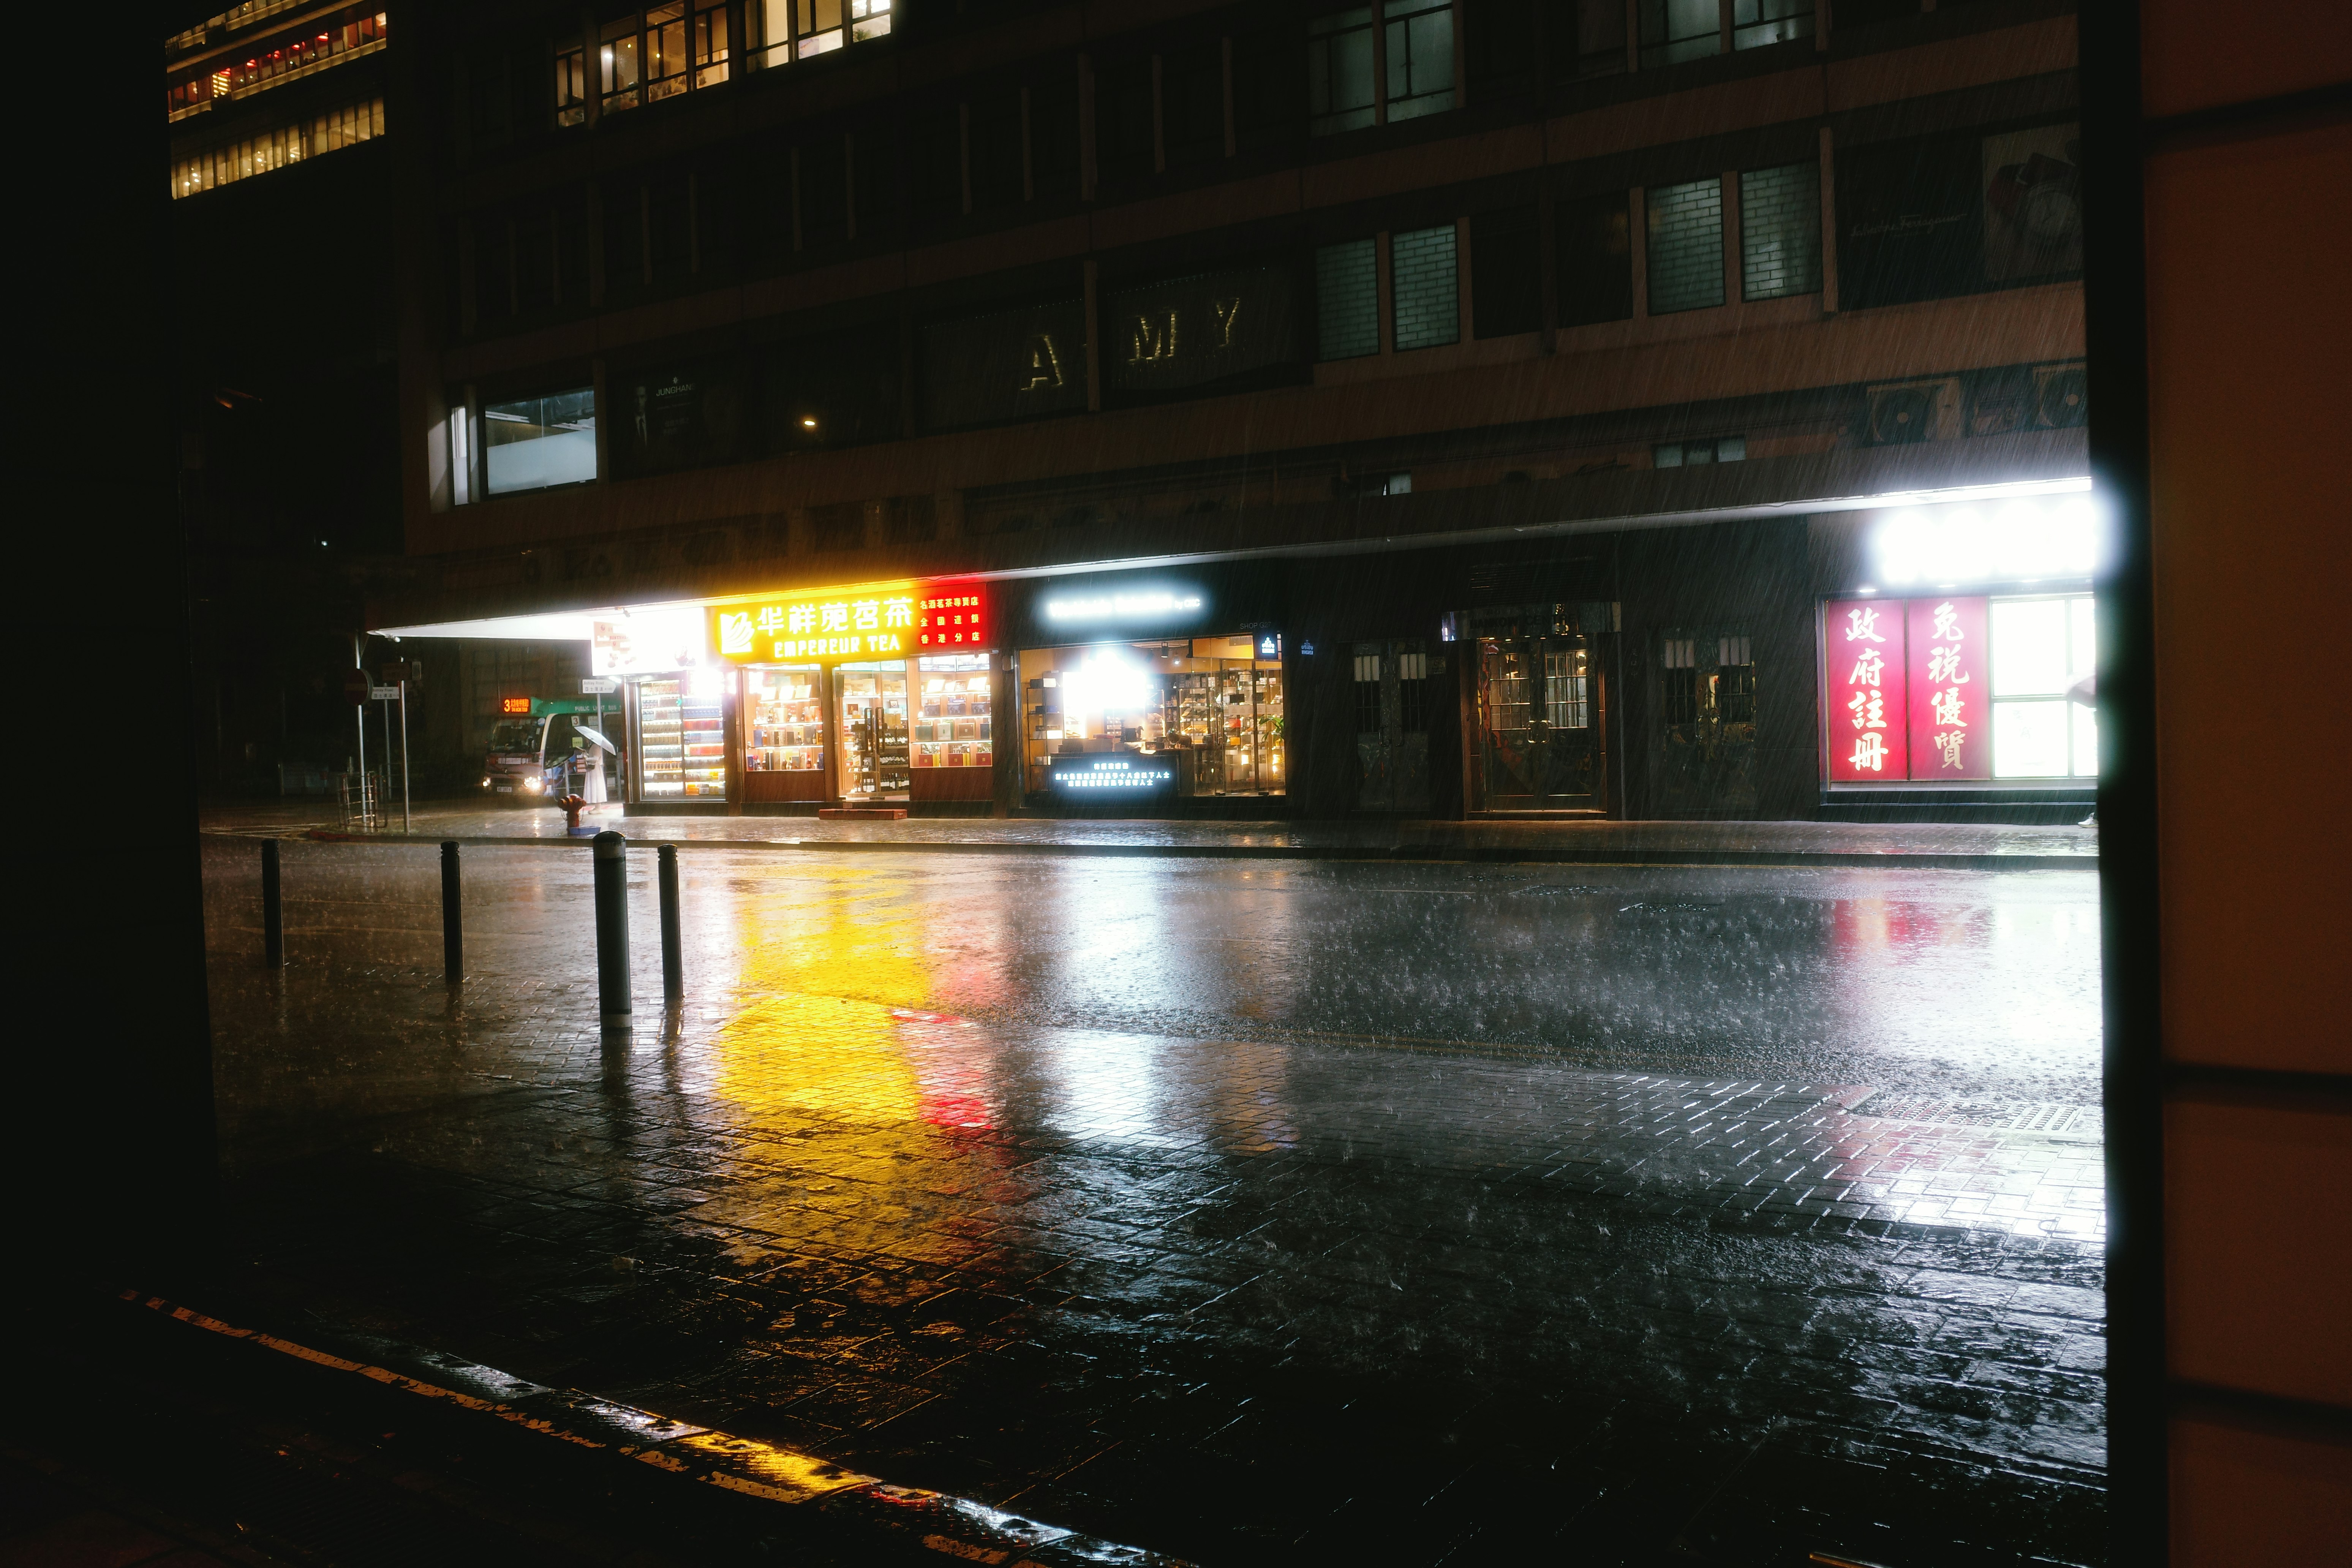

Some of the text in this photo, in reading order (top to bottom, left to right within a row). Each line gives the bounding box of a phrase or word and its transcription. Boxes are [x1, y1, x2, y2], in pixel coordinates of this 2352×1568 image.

[920, 596, 978, 610] 名酒茗茶專賣店
[920, 614, 979, 627] 全國連鎖
[867, 634, 901, 652] TEA
[921, 632, 980, 644] 香港分店
[1846, 607, 1889, 772] 政府註冊
[504, 699, 510, 712] 3
